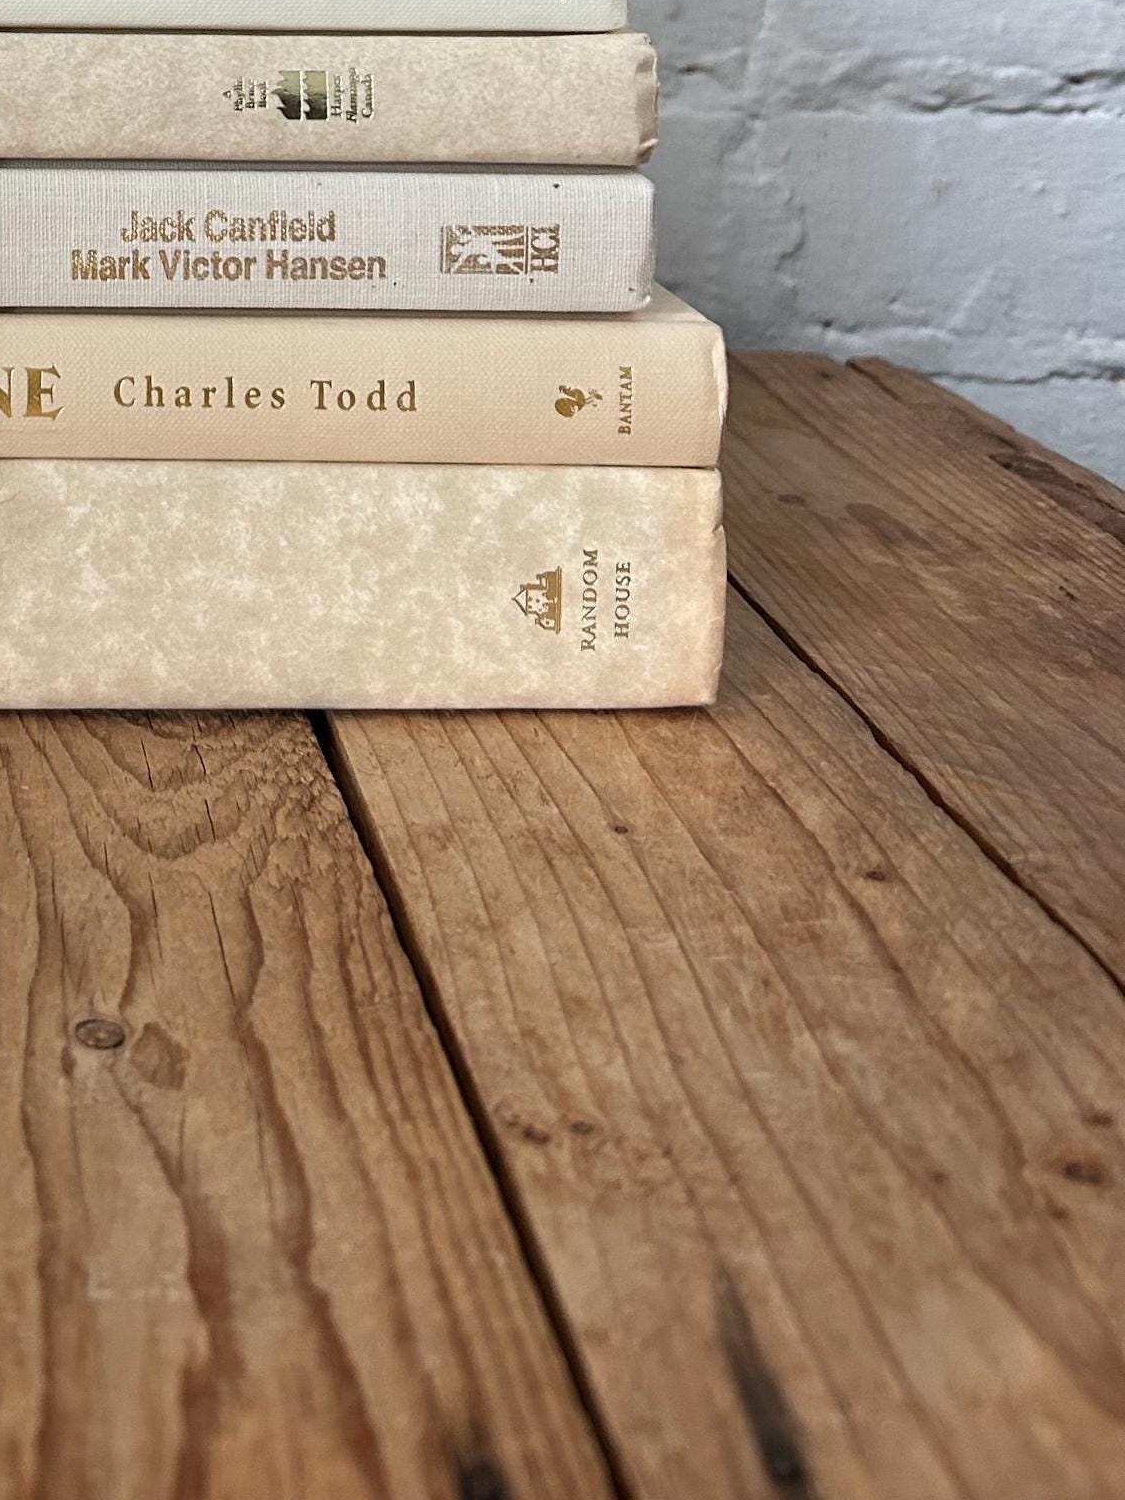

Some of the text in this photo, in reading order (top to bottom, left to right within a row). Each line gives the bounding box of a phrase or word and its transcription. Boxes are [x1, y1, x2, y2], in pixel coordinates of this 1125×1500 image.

[120, 209, 337, 243] Jack Canfield
[71, 249, 387, 282] Mark Victor Hansen
[113, 375, 417, 412] Charles Todd
[618, 366, 632, 435] BANTAM
[581, 549, 598, 651] RANDOM
[614, 562, 631, 638] HOUSE
